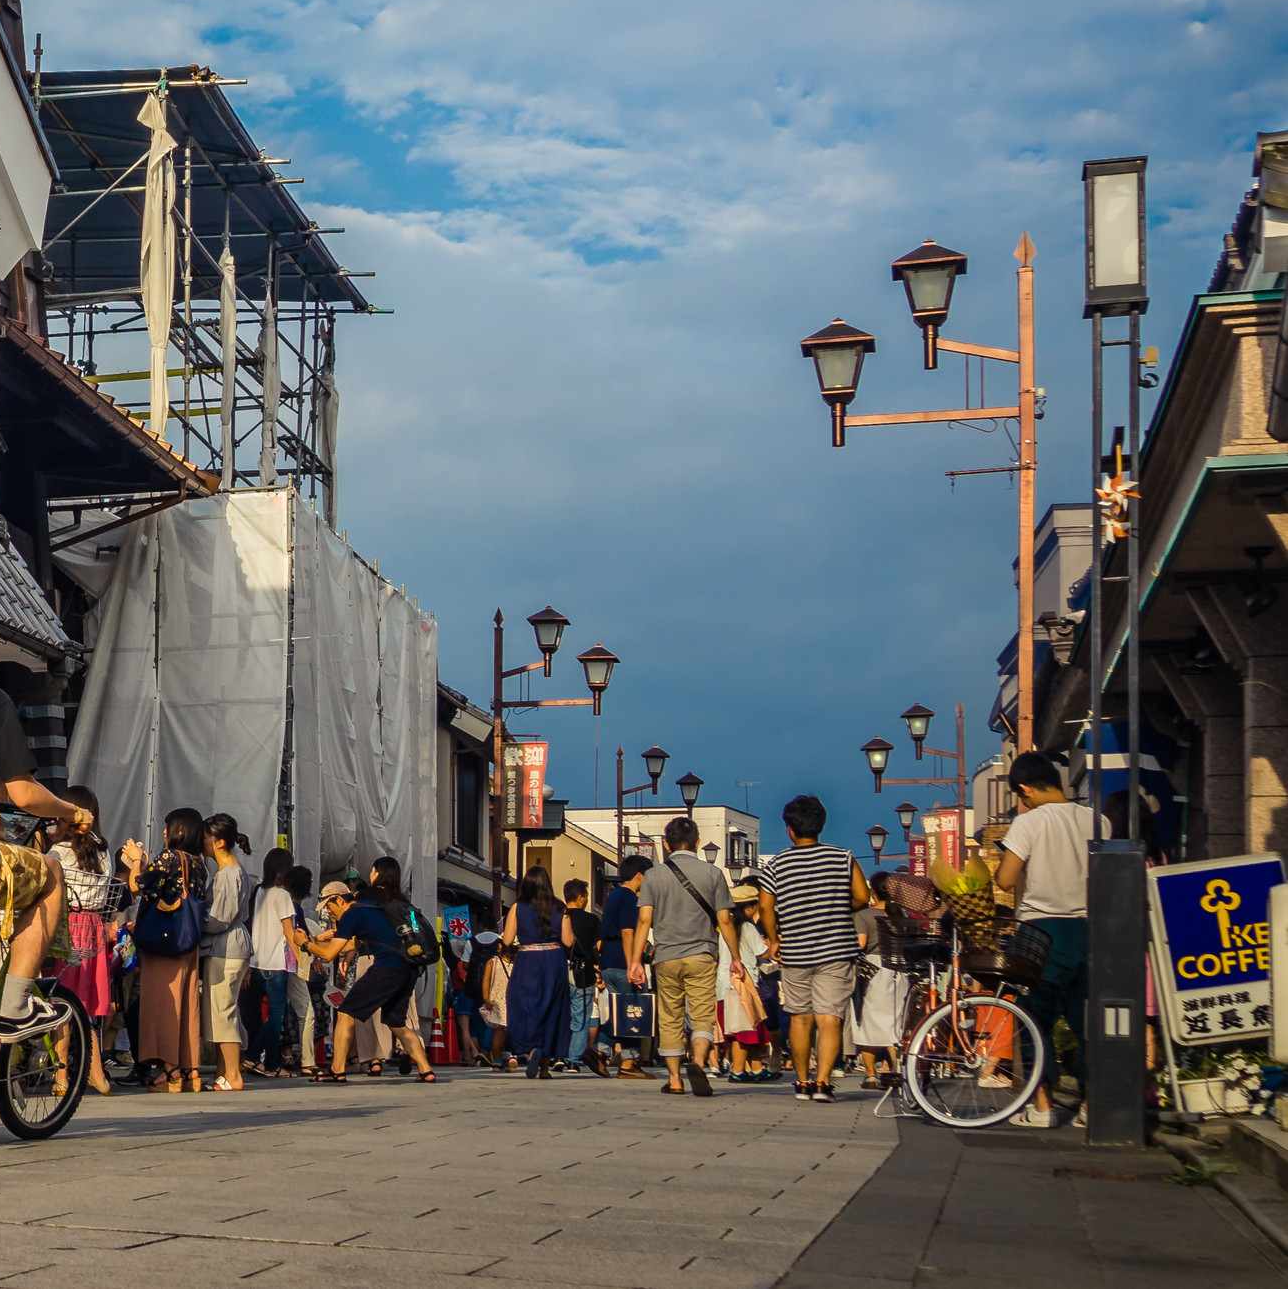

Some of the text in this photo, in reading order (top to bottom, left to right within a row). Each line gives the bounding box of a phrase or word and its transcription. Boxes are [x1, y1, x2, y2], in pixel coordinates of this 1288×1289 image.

[449, 917, 470, 937] 氷
[1230, 922, 1270, 947] KE
[1177, 947, 1270, 979] COFFE
